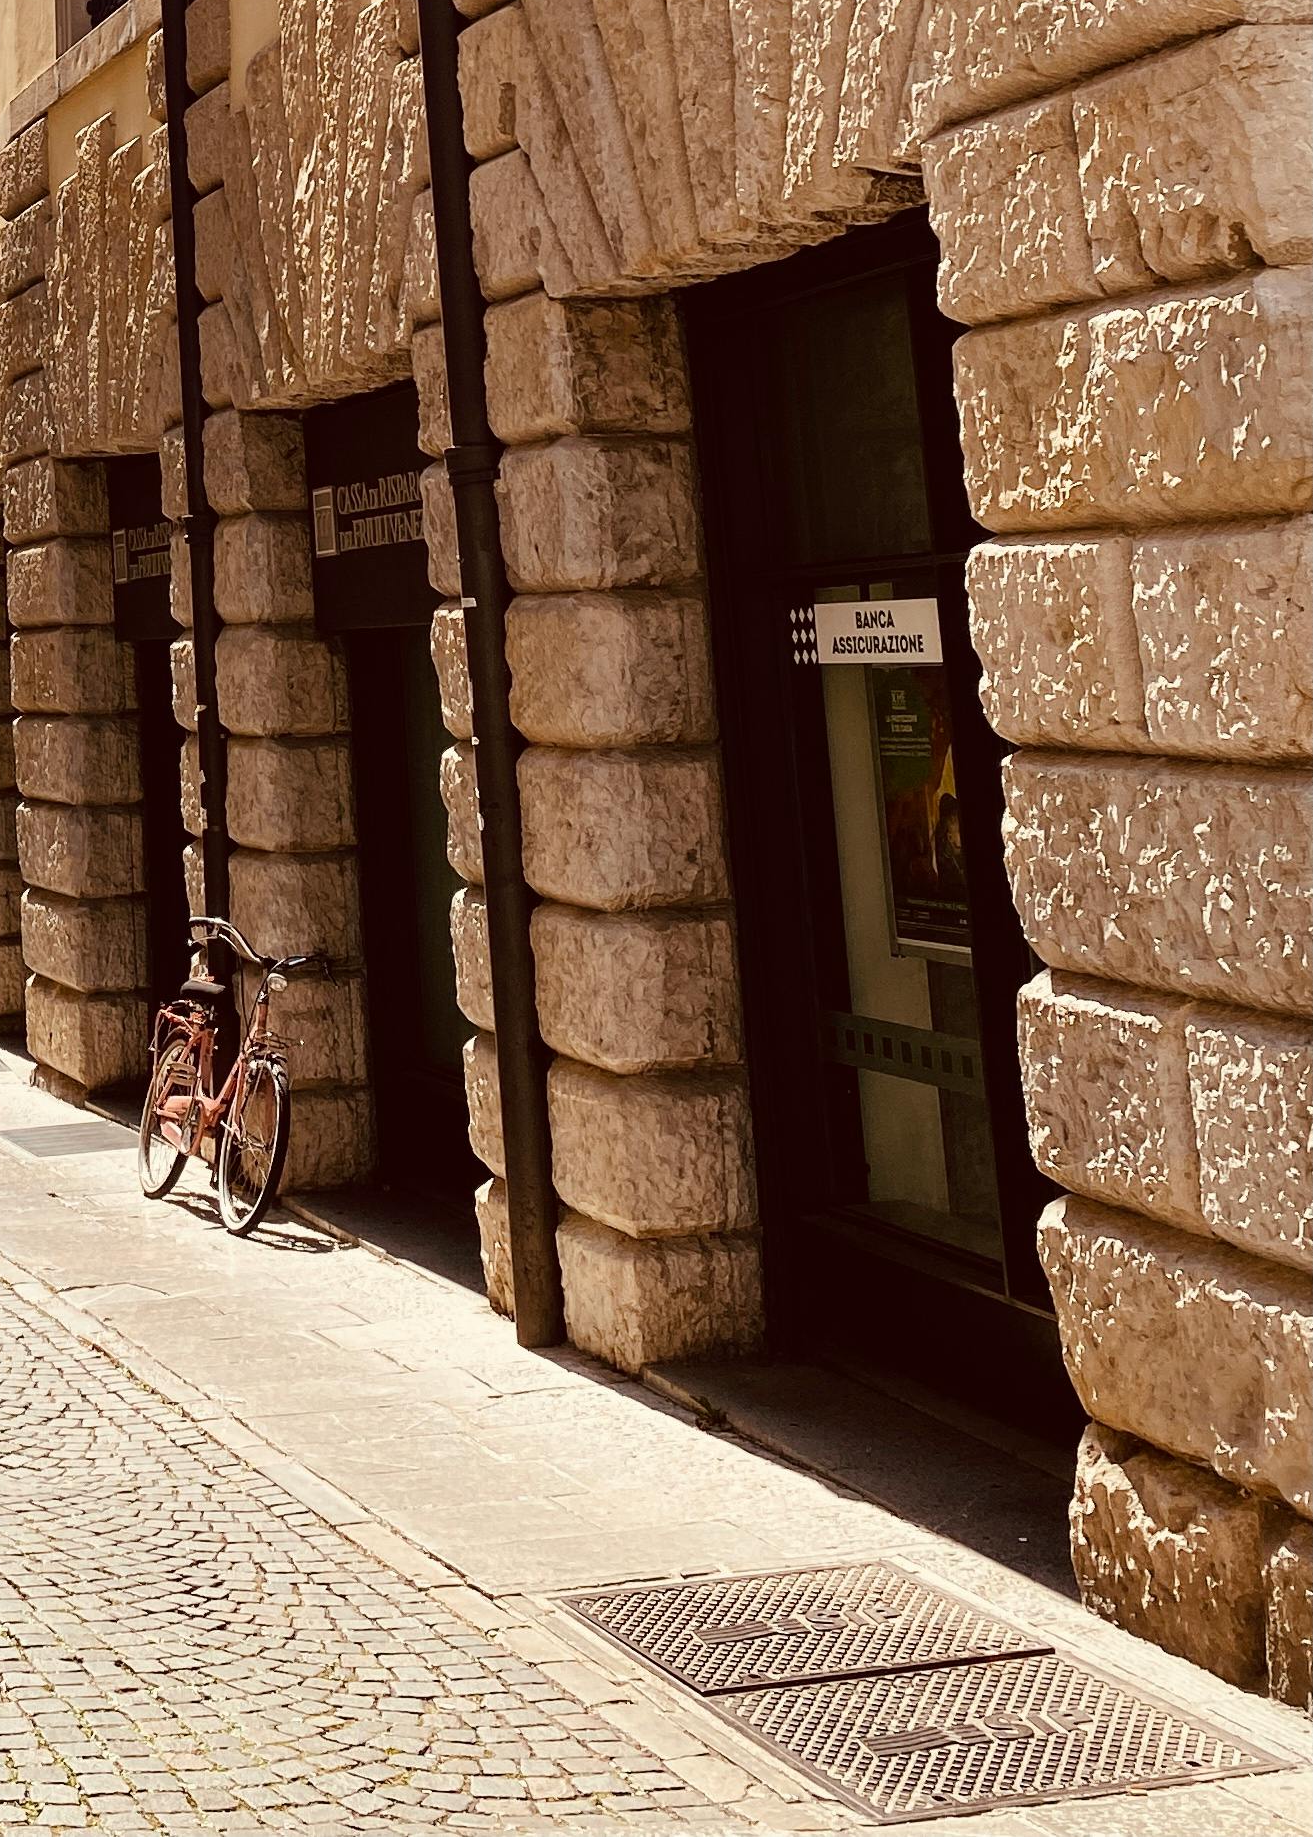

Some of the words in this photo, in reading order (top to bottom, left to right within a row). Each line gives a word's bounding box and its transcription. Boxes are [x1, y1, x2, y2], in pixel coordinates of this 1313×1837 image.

[336, 482, 369, 515] CASSA
[389, 509, 425, 543] VENEZ
[855, 610, 895, 629] BANCA
[832, 634, 924, 654] ASSICURAZIONE
